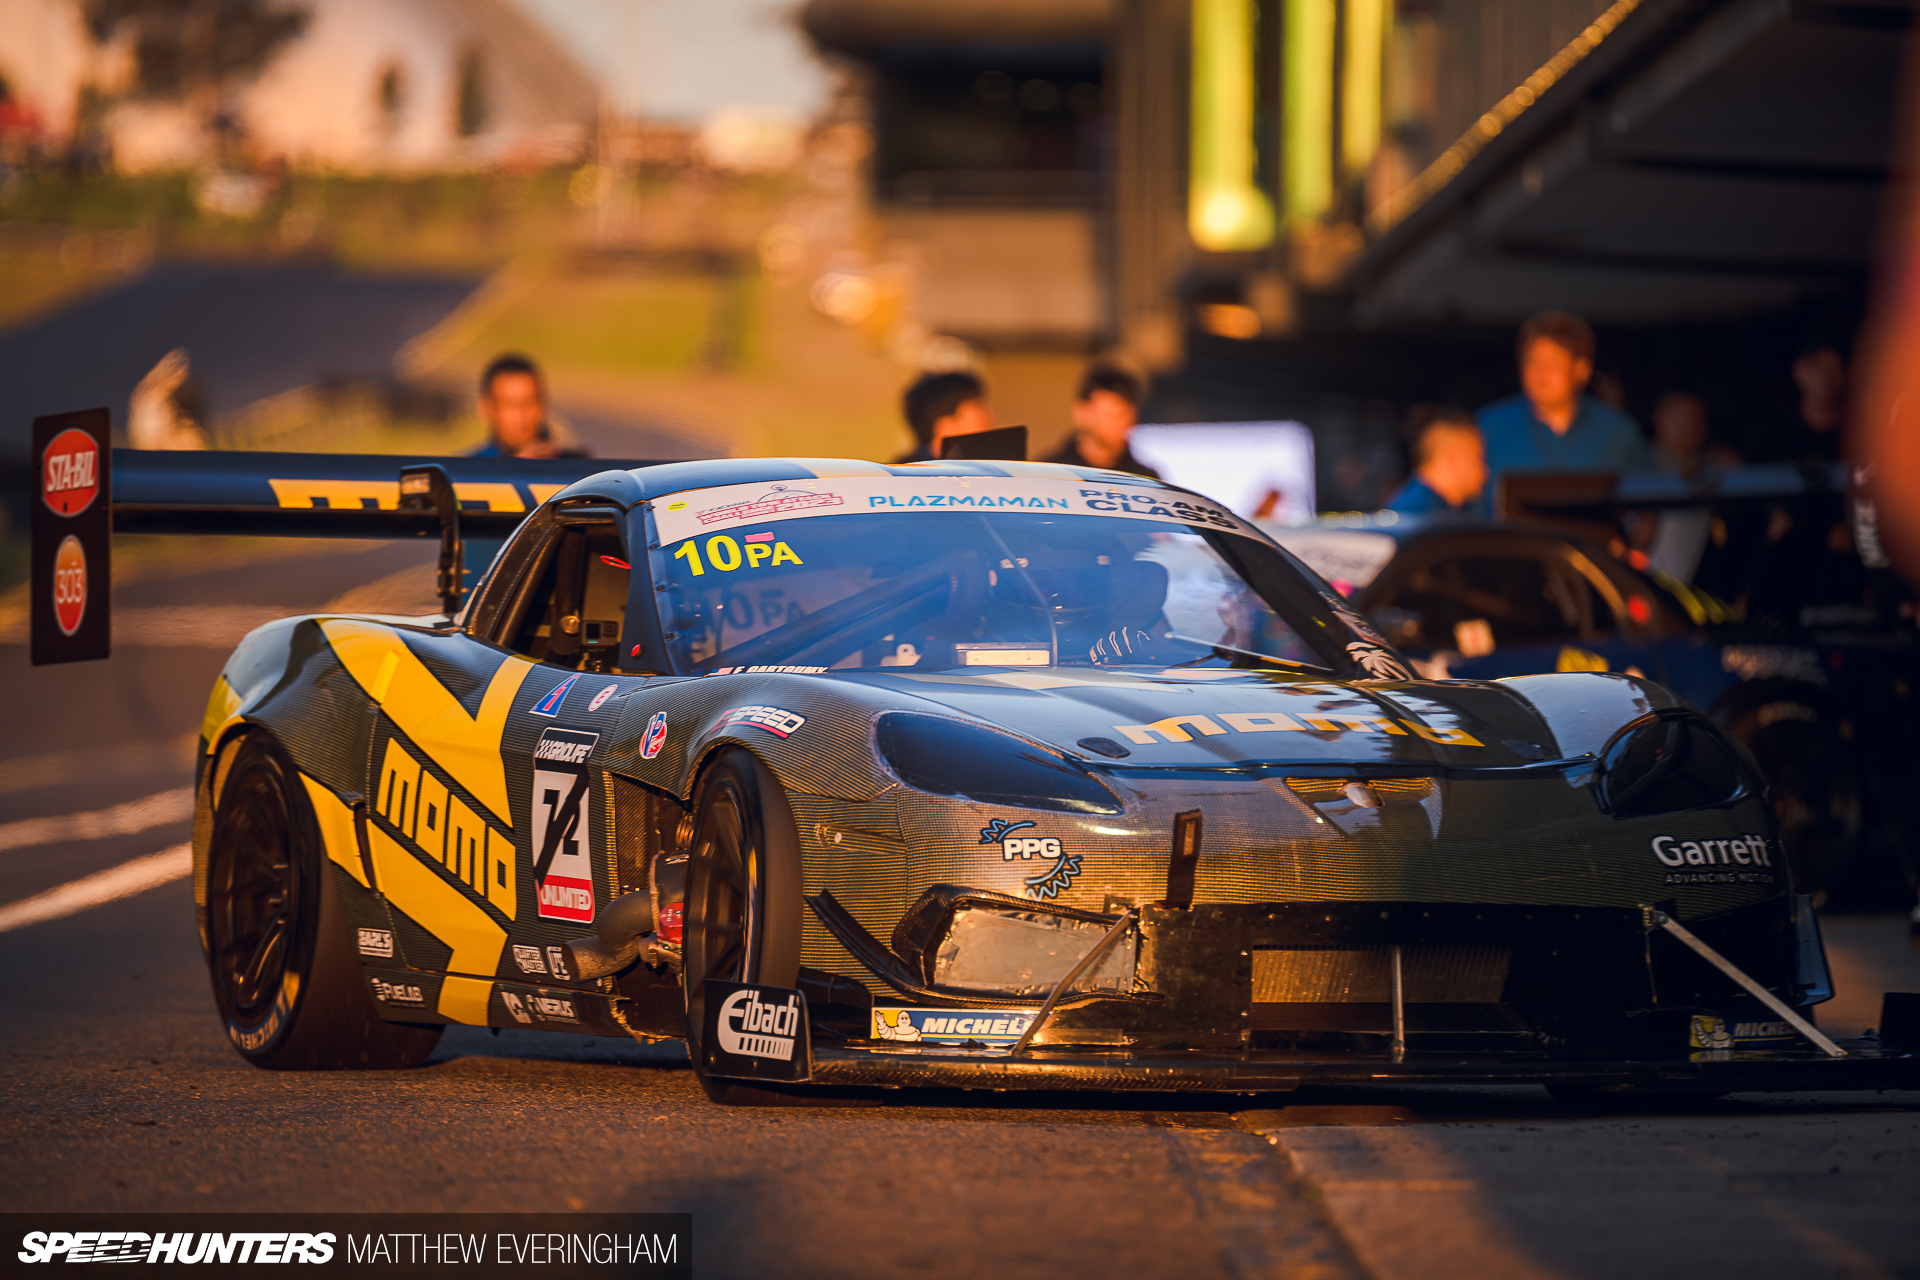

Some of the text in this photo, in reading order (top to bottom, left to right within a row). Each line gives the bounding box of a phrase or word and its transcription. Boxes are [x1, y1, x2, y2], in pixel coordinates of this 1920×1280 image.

[47, 451, 95, 492] STA-BIL
[869, 494, 1069, 509] PLAZMAMAN
[1079, 489, 1225, 518] PRO-AM
[1086, 499, 1240, 530] CLASS
[744, 541, 804, 568] PA
[57, 569, 83, 605] 303
[1003, 838, 1061, 860] PPG
[1651, 834, 1772, 867] Garrett
[1665, 872, 1736, 884] ADVANCING
[717, 989, 799, 1060] Eibach
[921, 1018, 1037, 1035] MICHEL
